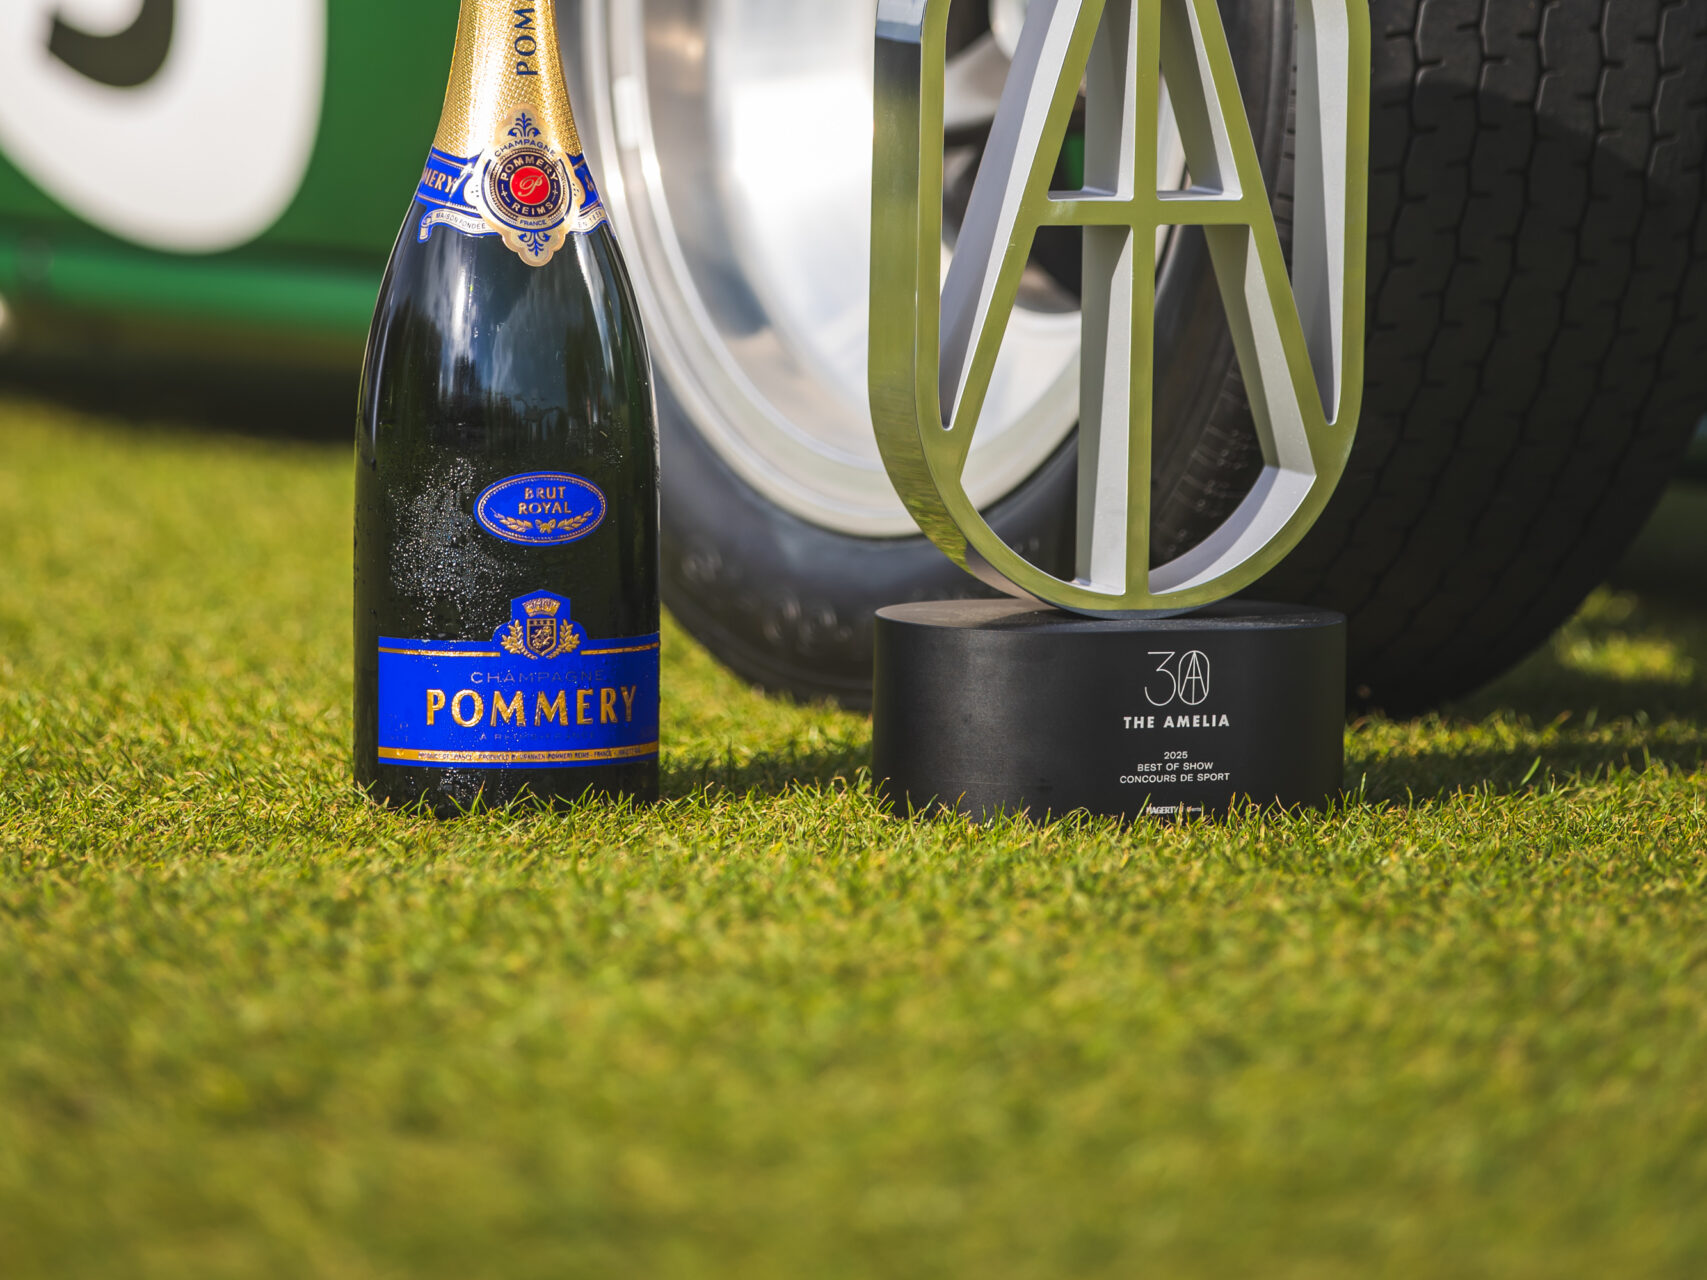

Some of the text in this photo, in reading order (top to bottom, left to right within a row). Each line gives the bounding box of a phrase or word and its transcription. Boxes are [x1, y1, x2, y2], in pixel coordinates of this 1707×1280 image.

[494, 138, 557, 158] CHAMPAGNE
[500, 156, 559, 181] POMMERY
[511, 201, 554, 216] REIMS
[520, 219, 547, 227] FRANCE
[525, 486, 567, 500] BRUT
[518, 500, 572, 515] ROYAL
[470, 670, 605, 684] CHAMPAGNE
[426, 686, 637, 727] POMMERY
[1123, 714, 1230, 729] THE AMELIA
[1164, 751, 1188, 760] 2025
[1137, 762, 1213, 772] BEST OF SHOW
[1120, 773, 1230, 784] CONCOURS DE SPORT
